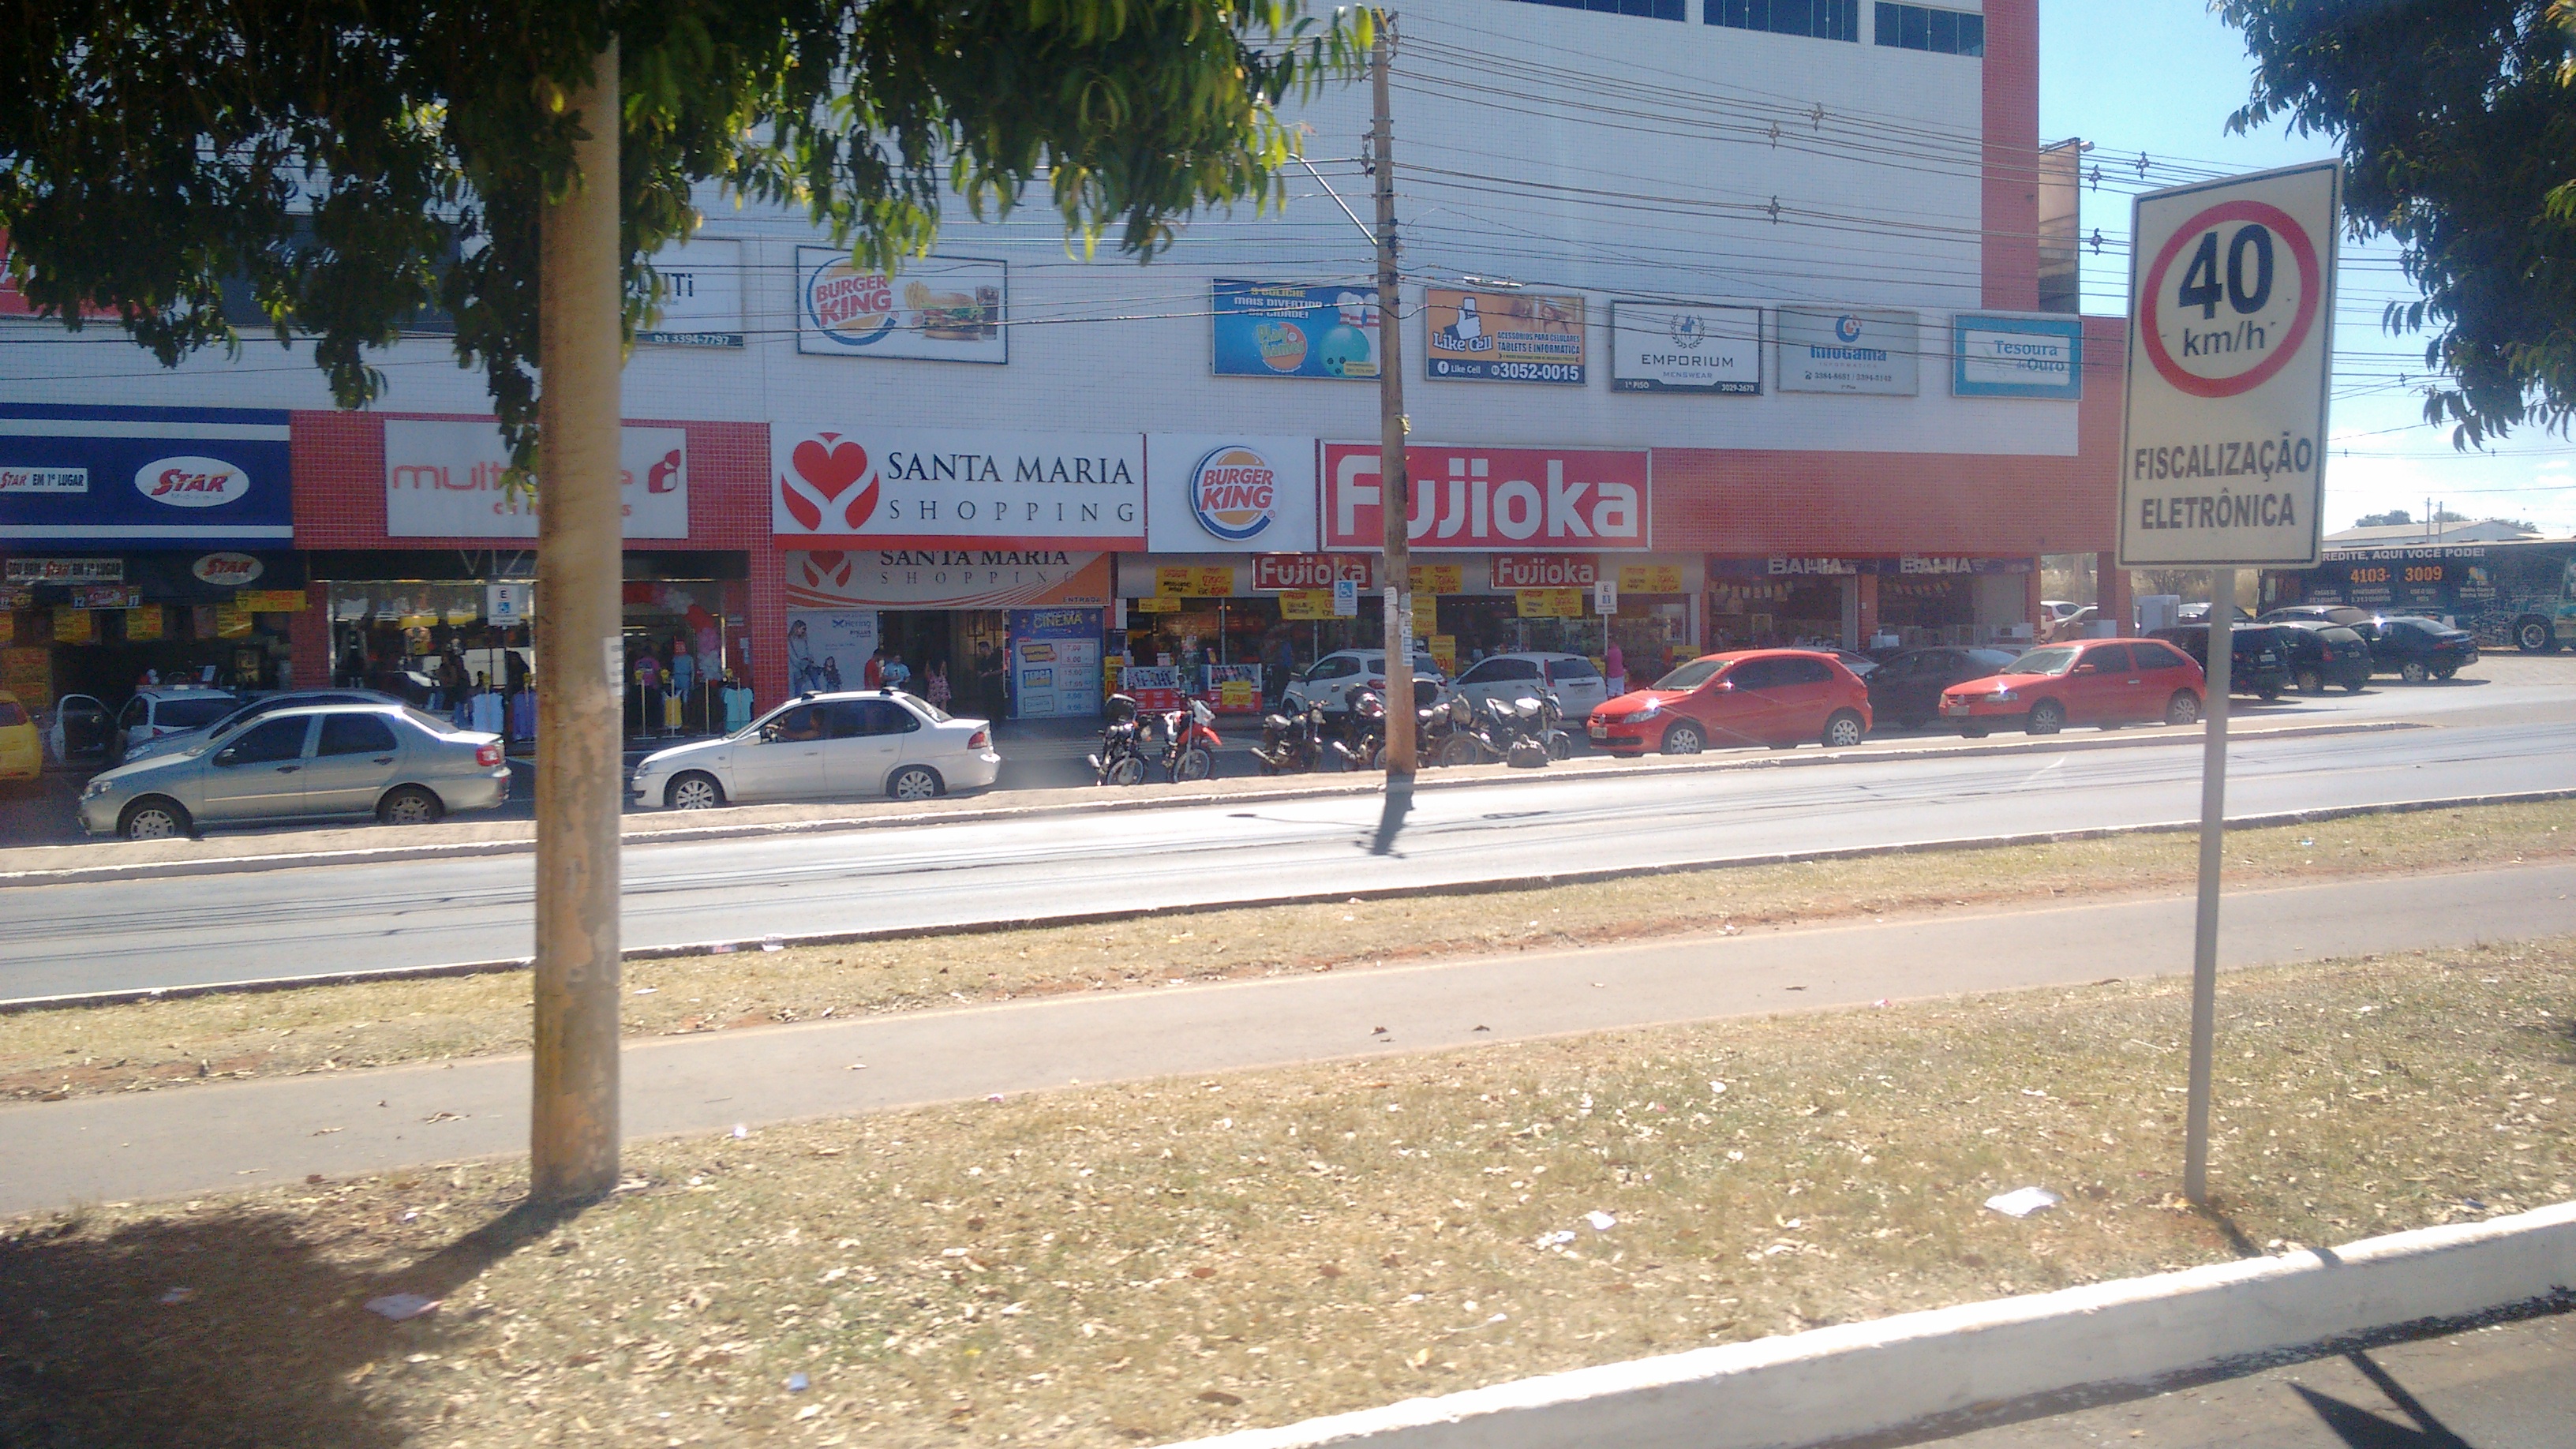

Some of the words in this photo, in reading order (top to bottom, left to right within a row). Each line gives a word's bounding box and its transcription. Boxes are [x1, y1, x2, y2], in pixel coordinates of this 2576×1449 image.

[2178, 223, 2274, 320] 40
[816, 275, 889, 303] BURGER
[819, 290, 893, 327] KING
[1234, 297, 1264, 306] MAIS
[1267, 298, 1324, 309] DIVERTIDO
[1257, 324, 1289, 345] Play
[1432, 331, 1466, 352] Like
[1469, 335, 1493, 352] Cell
[1497, 331, 1533, 340] ACESSÓRIOS
[1550, 334, 1580, 343] CELULARES
[2182, 320, 2266, 358] km/h
[1262, 340, 1305, 358] Games
[1497, 342, 1527, 352] TABLETS
[1528, 343, 1533, 352] E
[1994, 339, 2058, 356] Tesoura
[1451, 363, 1466, 373] Like
[1467, 365, 1481, 374] Cell
[1642, 354, 1734, 368] EMPORIUM
[2027, 358, 2065, 372] Ouro
[1500, 362, 1579, 380] 3052-0015
[2135, 432, 2313, 481] FISCALIZAÇÃO
[888, 451, 1004, 484] SANTA
[1014, 455, 1135, 485] MARIA
[32, 474, 44, 486] EM
[58, 474, 84, 486] LUGAR
[1202, 468, 1274, 487] BURGER
[1199, 485, 1274, 511] KING
[1337, 455, 1638, 540] Fujioka
[889, 500, 1135, 522] SHOPPING
[2140, 488, 2295, 530] ELETRÔNICA
[881, 551, 972, 566] SANTA
[980, 551, 1069, 566] MARIA
[2372, 549, 2403, 560] AQUI
[2407, 546, 2442, 559] VOCÊ
[2445, 548, 2485, 558] PODE!
[1260, 556, 1367, 585] Fujioka
[1500, 558, 1594, 585] Fujioka
[1768, 558, 1843, 575] BAHIA
[1900, 557, 1972, 574] BAHIA
[881, 571, 1075, 585] SHOPPING
[2350, 567, 2391, 584] 4103-
[2404, 566, 2443, 582] 3009
[1033, 613, 1083, 629] CINEMA
